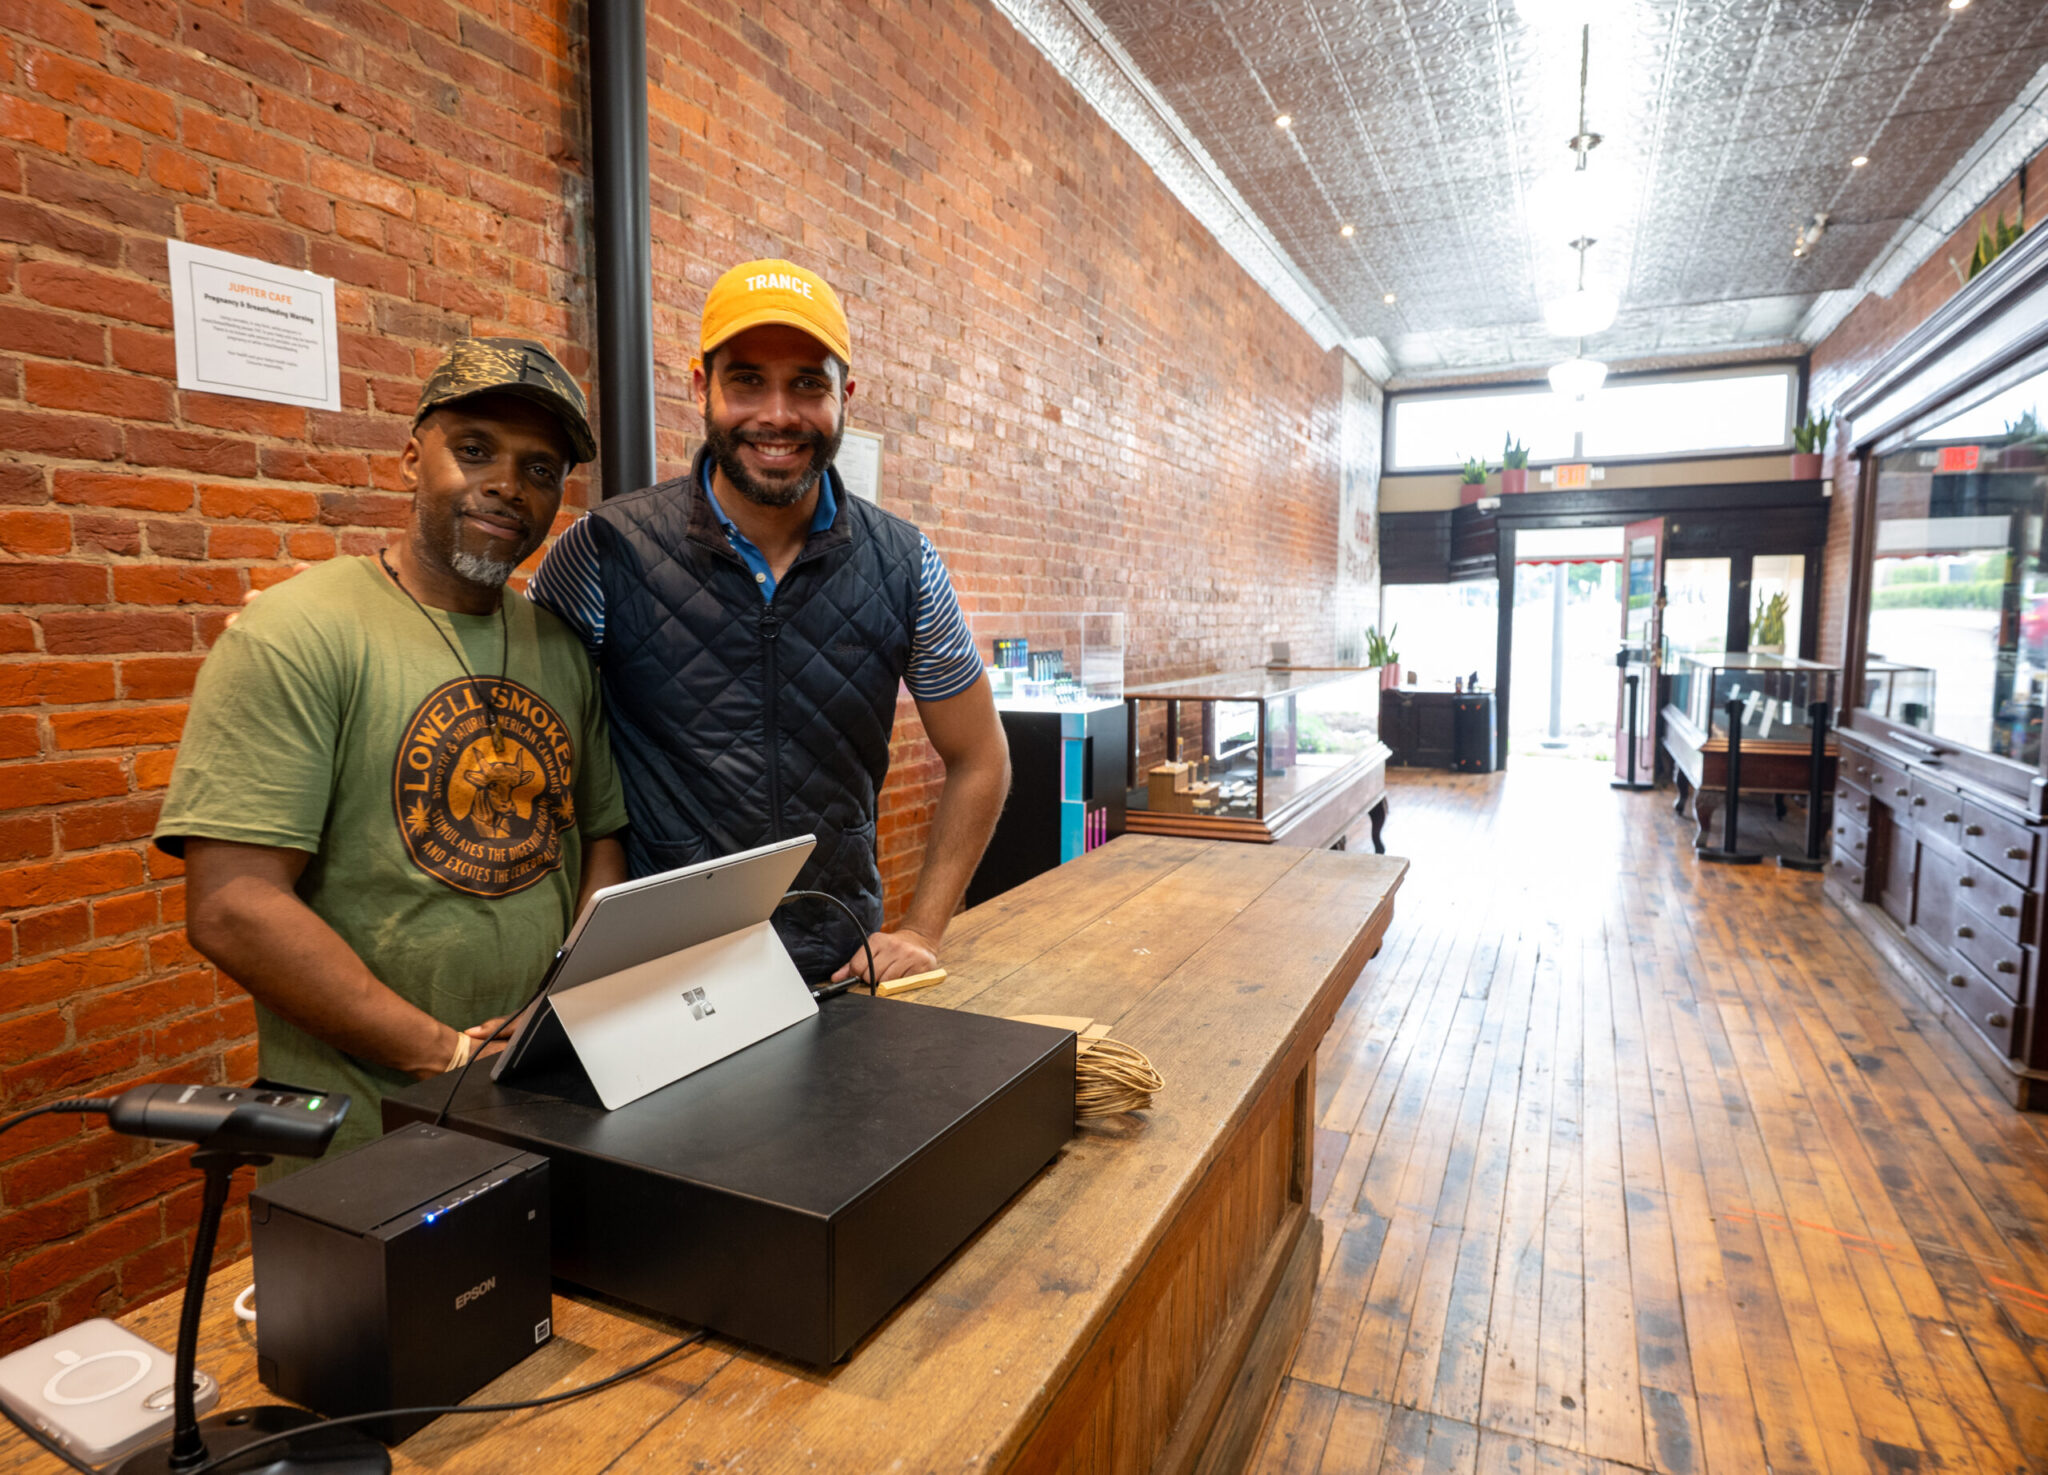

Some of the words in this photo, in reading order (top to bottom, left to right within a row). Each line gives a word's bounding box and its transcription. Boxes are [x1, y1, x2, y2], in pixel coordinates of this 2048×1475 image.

[229, 282, 266, 298] JUPITER
[269, 292, 293, 305] CAFE
[745, 273, 814, 301] TRANCE
[204, 293, 239, 307] Pregnancy
[289, 312, 314, 324] Warning
[404, 688, 483, 793] LOWELL
[432, 752, 452, 799] SMOOTH
[446, 742, 460, 755] &
[495, 715, 538, 745] MERICAN
[536, 741, 561, 794] CANNABIS
[431, 808, 485, 859] STIMULATES
[488, 847, 507, 862] THE
[421, 840, 448, 863] AND
[444, 856, 492, 883] EXCITES
[494, 869, 511, 883] THE
[455, 1276, 496, 1310] EPSON
